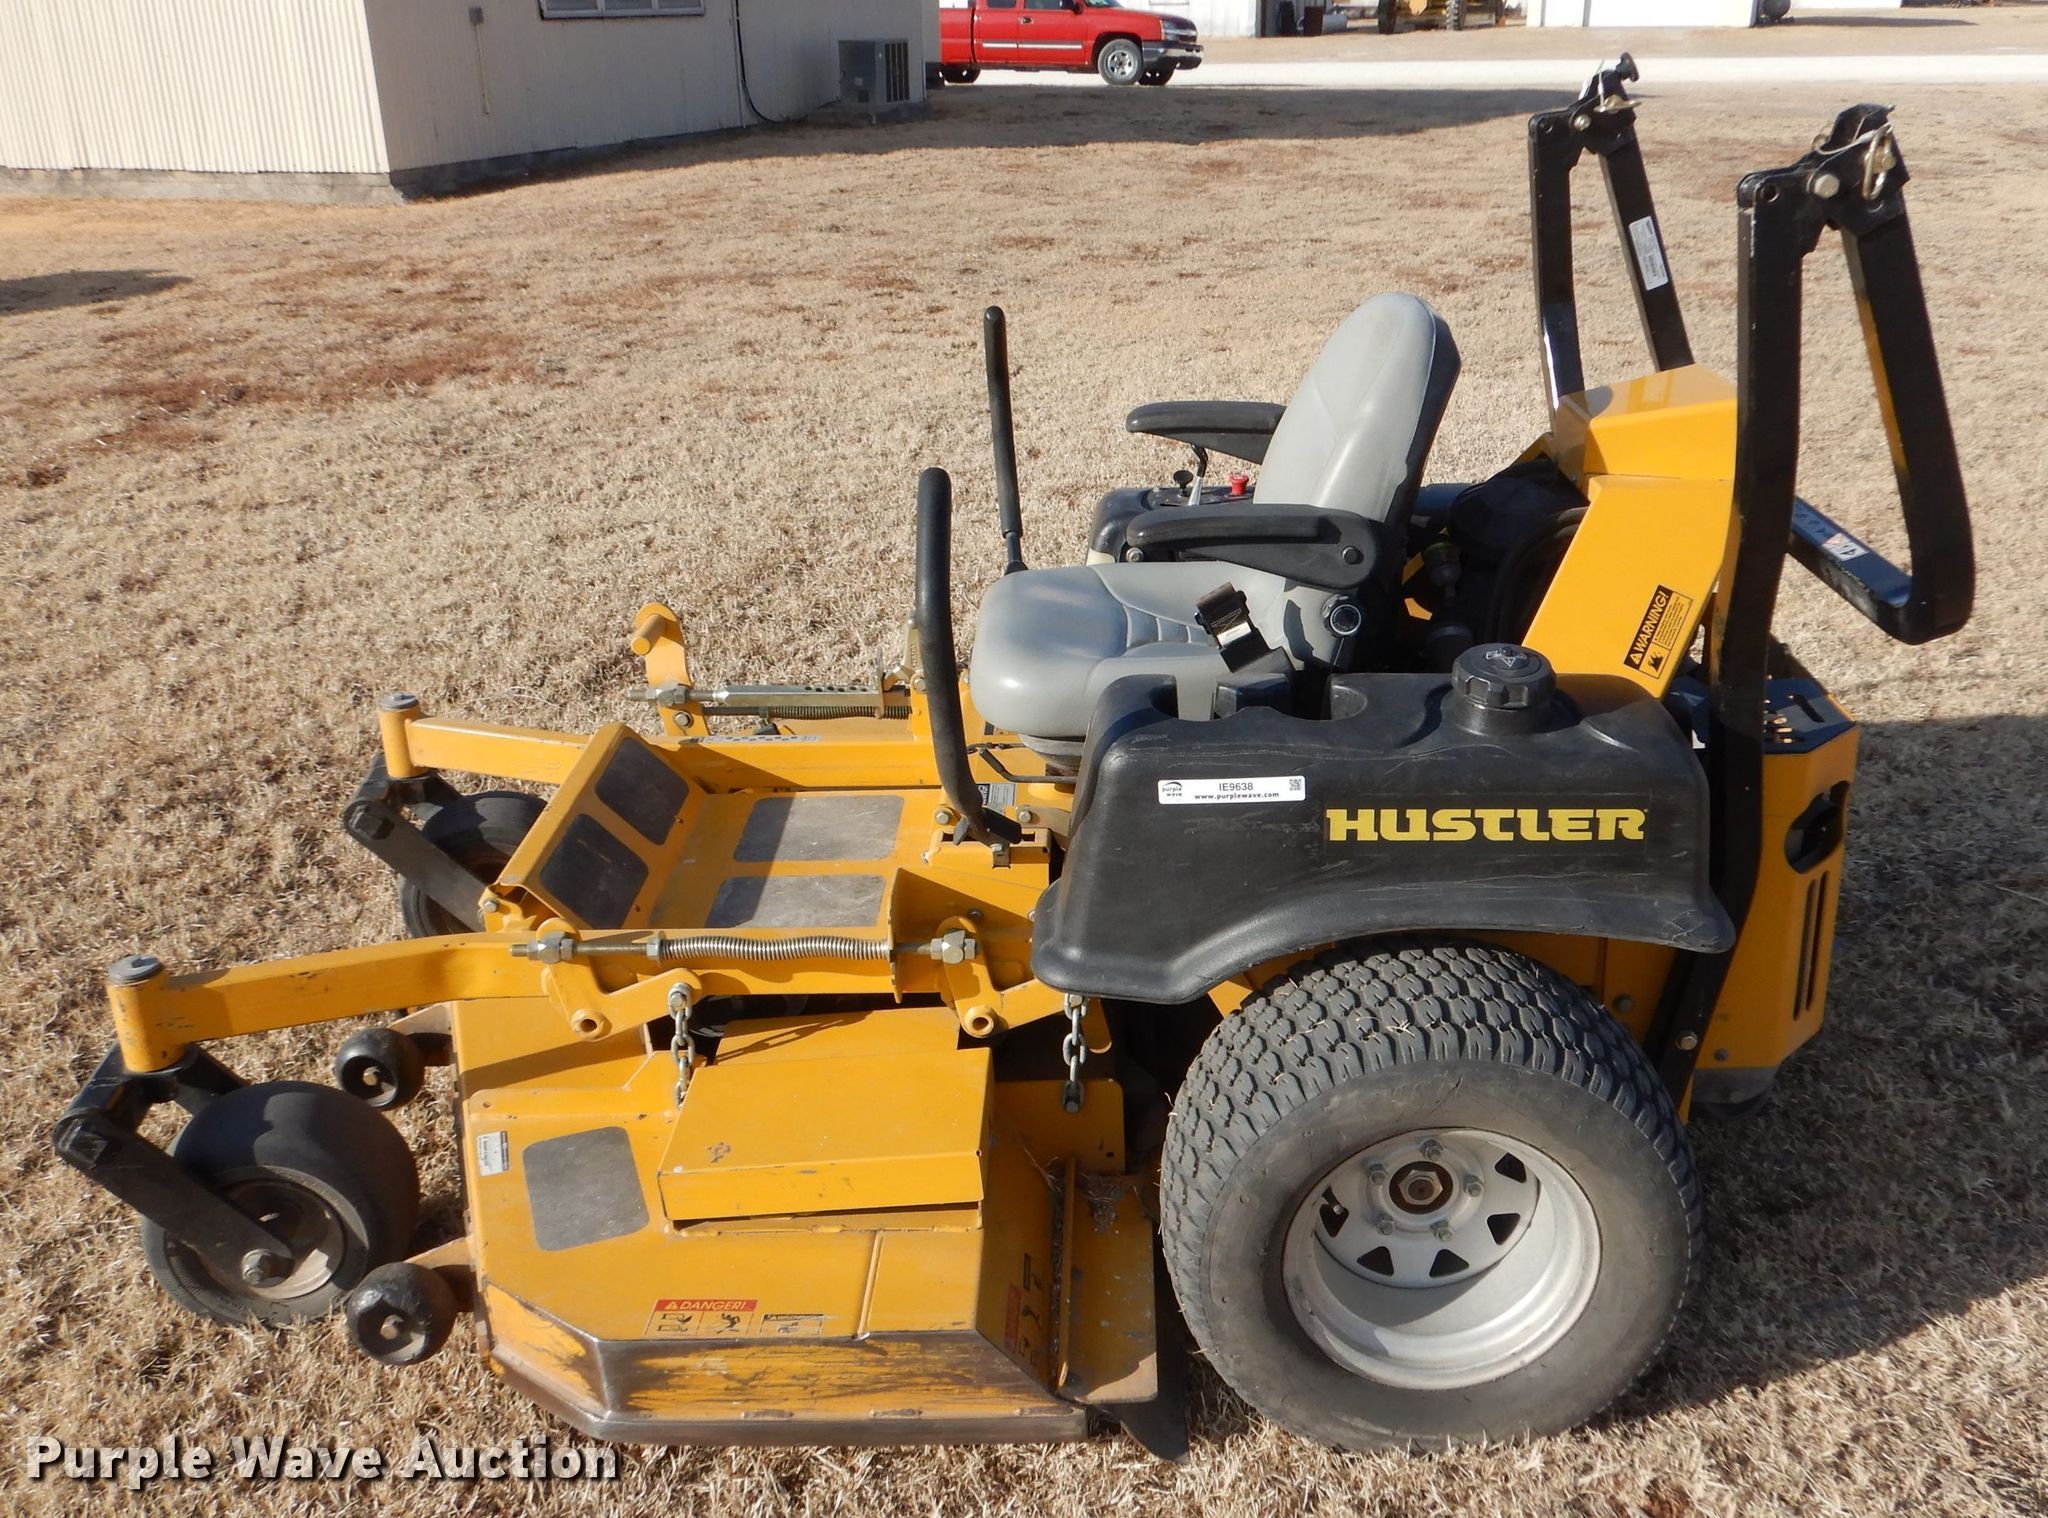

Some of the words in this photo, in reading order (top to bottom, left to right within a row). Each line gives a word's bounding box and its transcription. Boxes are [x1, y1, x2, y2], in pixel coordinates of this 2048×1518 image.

[1634, 590, 1669, 652] WARNING!
[1218, 782, 1254, 792] IE9638
[1194, 791, 1280, 800] www.purplewave.com
[1326, 808, 1646, 842] HUSTLER
[679, 1300, 746, 1311] DANGER!
